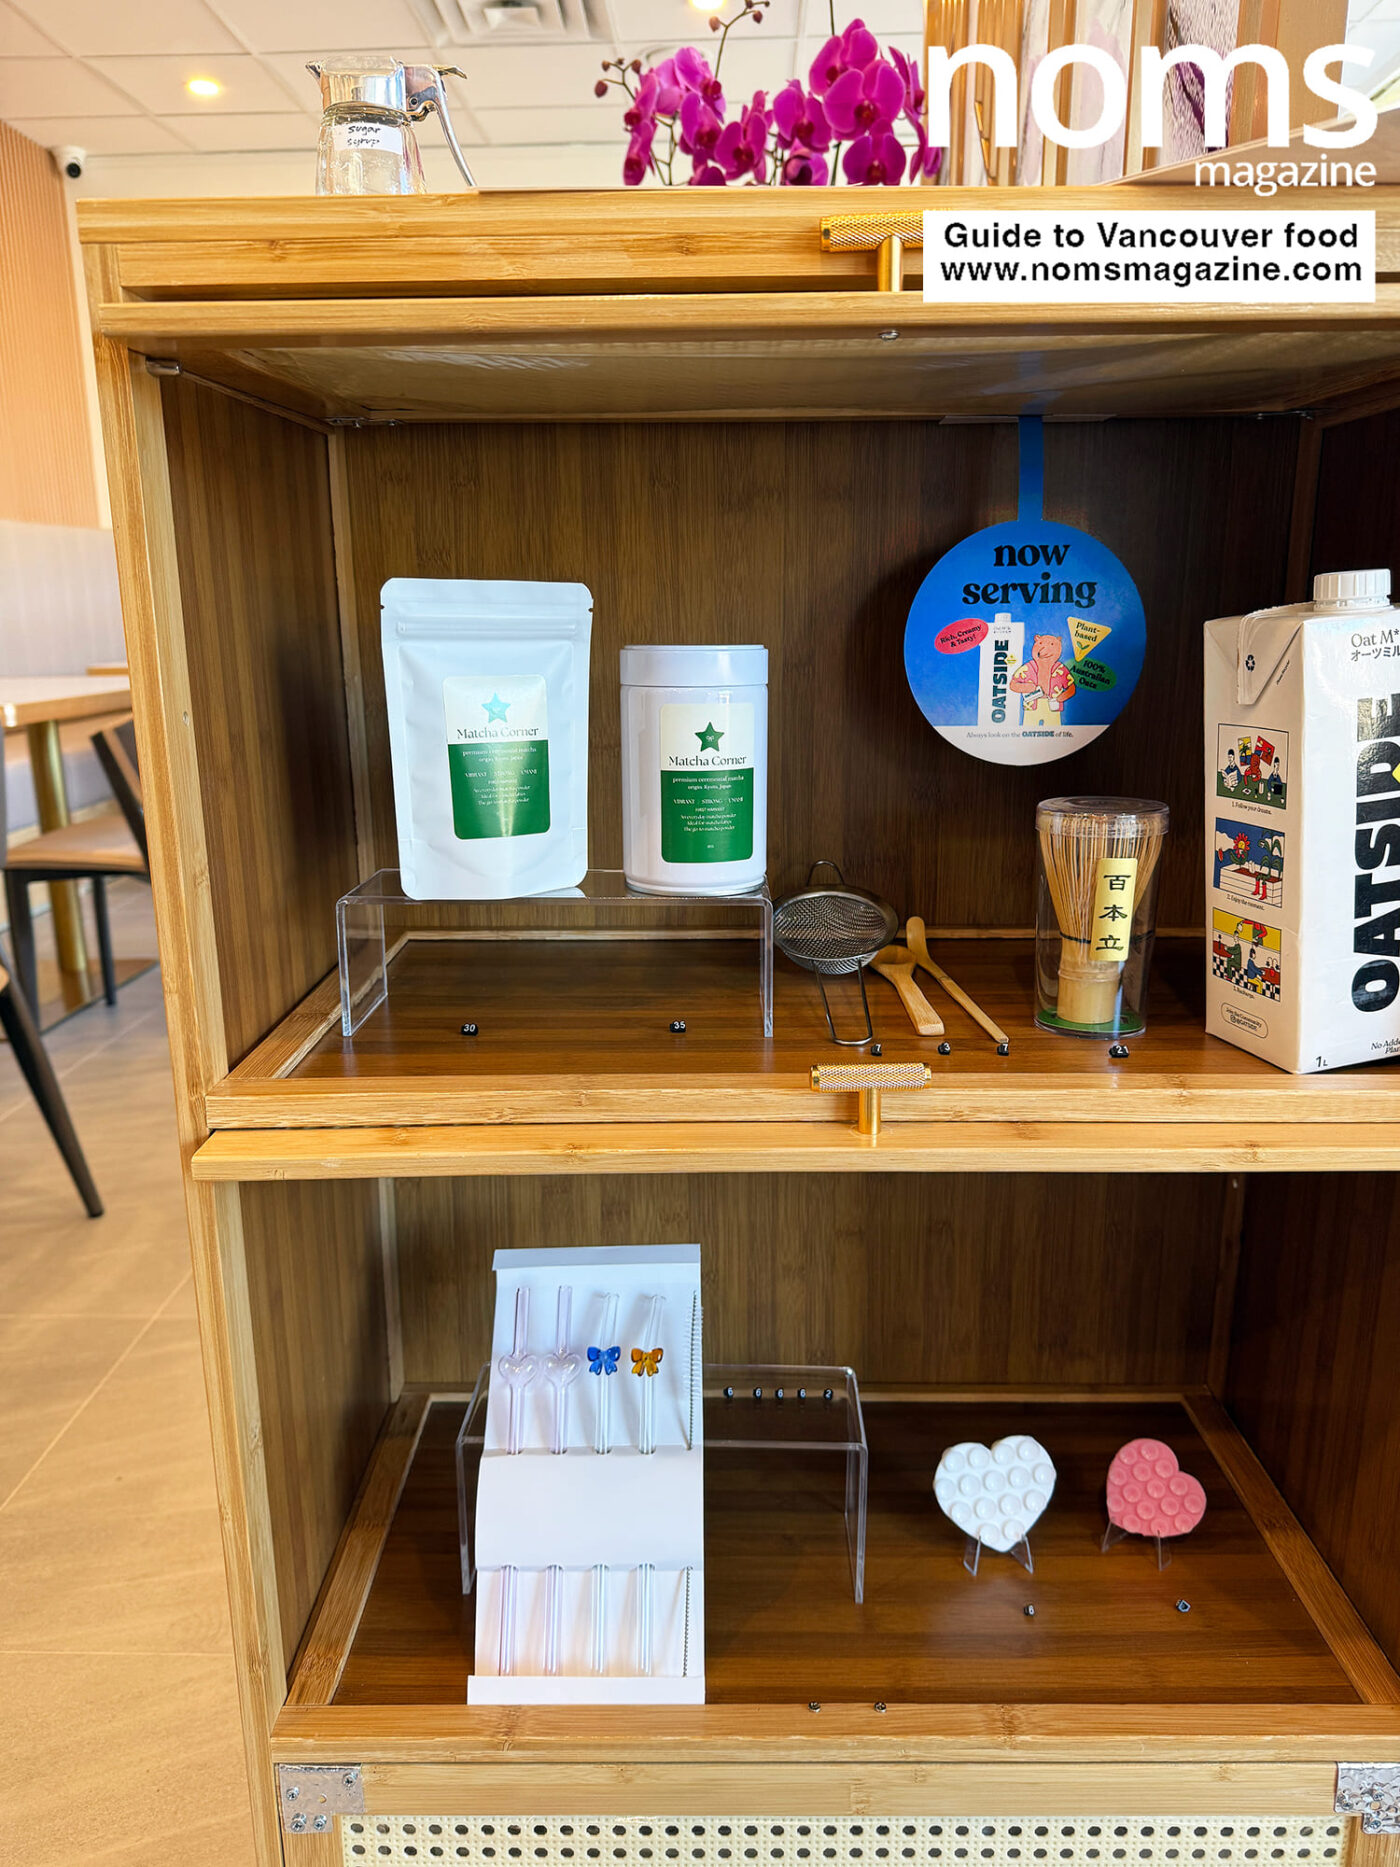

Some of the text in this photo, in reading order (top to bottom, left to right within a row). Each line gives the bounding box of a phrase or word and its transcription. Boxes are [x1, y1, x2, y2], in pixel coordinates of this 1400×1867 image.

[348, 126, 381, 136] sugar
[993, 544, 1071, 567] now
[962, 572, 1097, 609] serving
[957, 624, 982, 638] Creamy
[1076, 622, 1100, 634] Plant-
[1074, 631, 1097, 642] based
[1351, 633, 1378, 648] Oat
[1083, 659, 1106, 673] 100%
[1070, 665, 1111, 685] Australian
[991, 640, 1009, 723] OATSIDE
[1079, 677, 1097, 689] Oats
[457, 727, 539, 740] Matcha Corner
[669, 755, 747, 766] Matcha Corner
[1350, 692, 1400, 1013] OATSIDE
[1095, 875, 1131, 951] 百本立
[463, 1023, 476, 1032] 30
[673, 1020, 686, 1029] 35
[875, 1043, 881, 1052] 7
[943, 1042, 951, 1051] 3
[1002, 1043, 1008, 1051] 7
[1116, 1045, 1129, 1054] 21
[1371, 1041, 1382, 1050] No
[727, 1387, 831, 1398] 6 6 6 6 2
